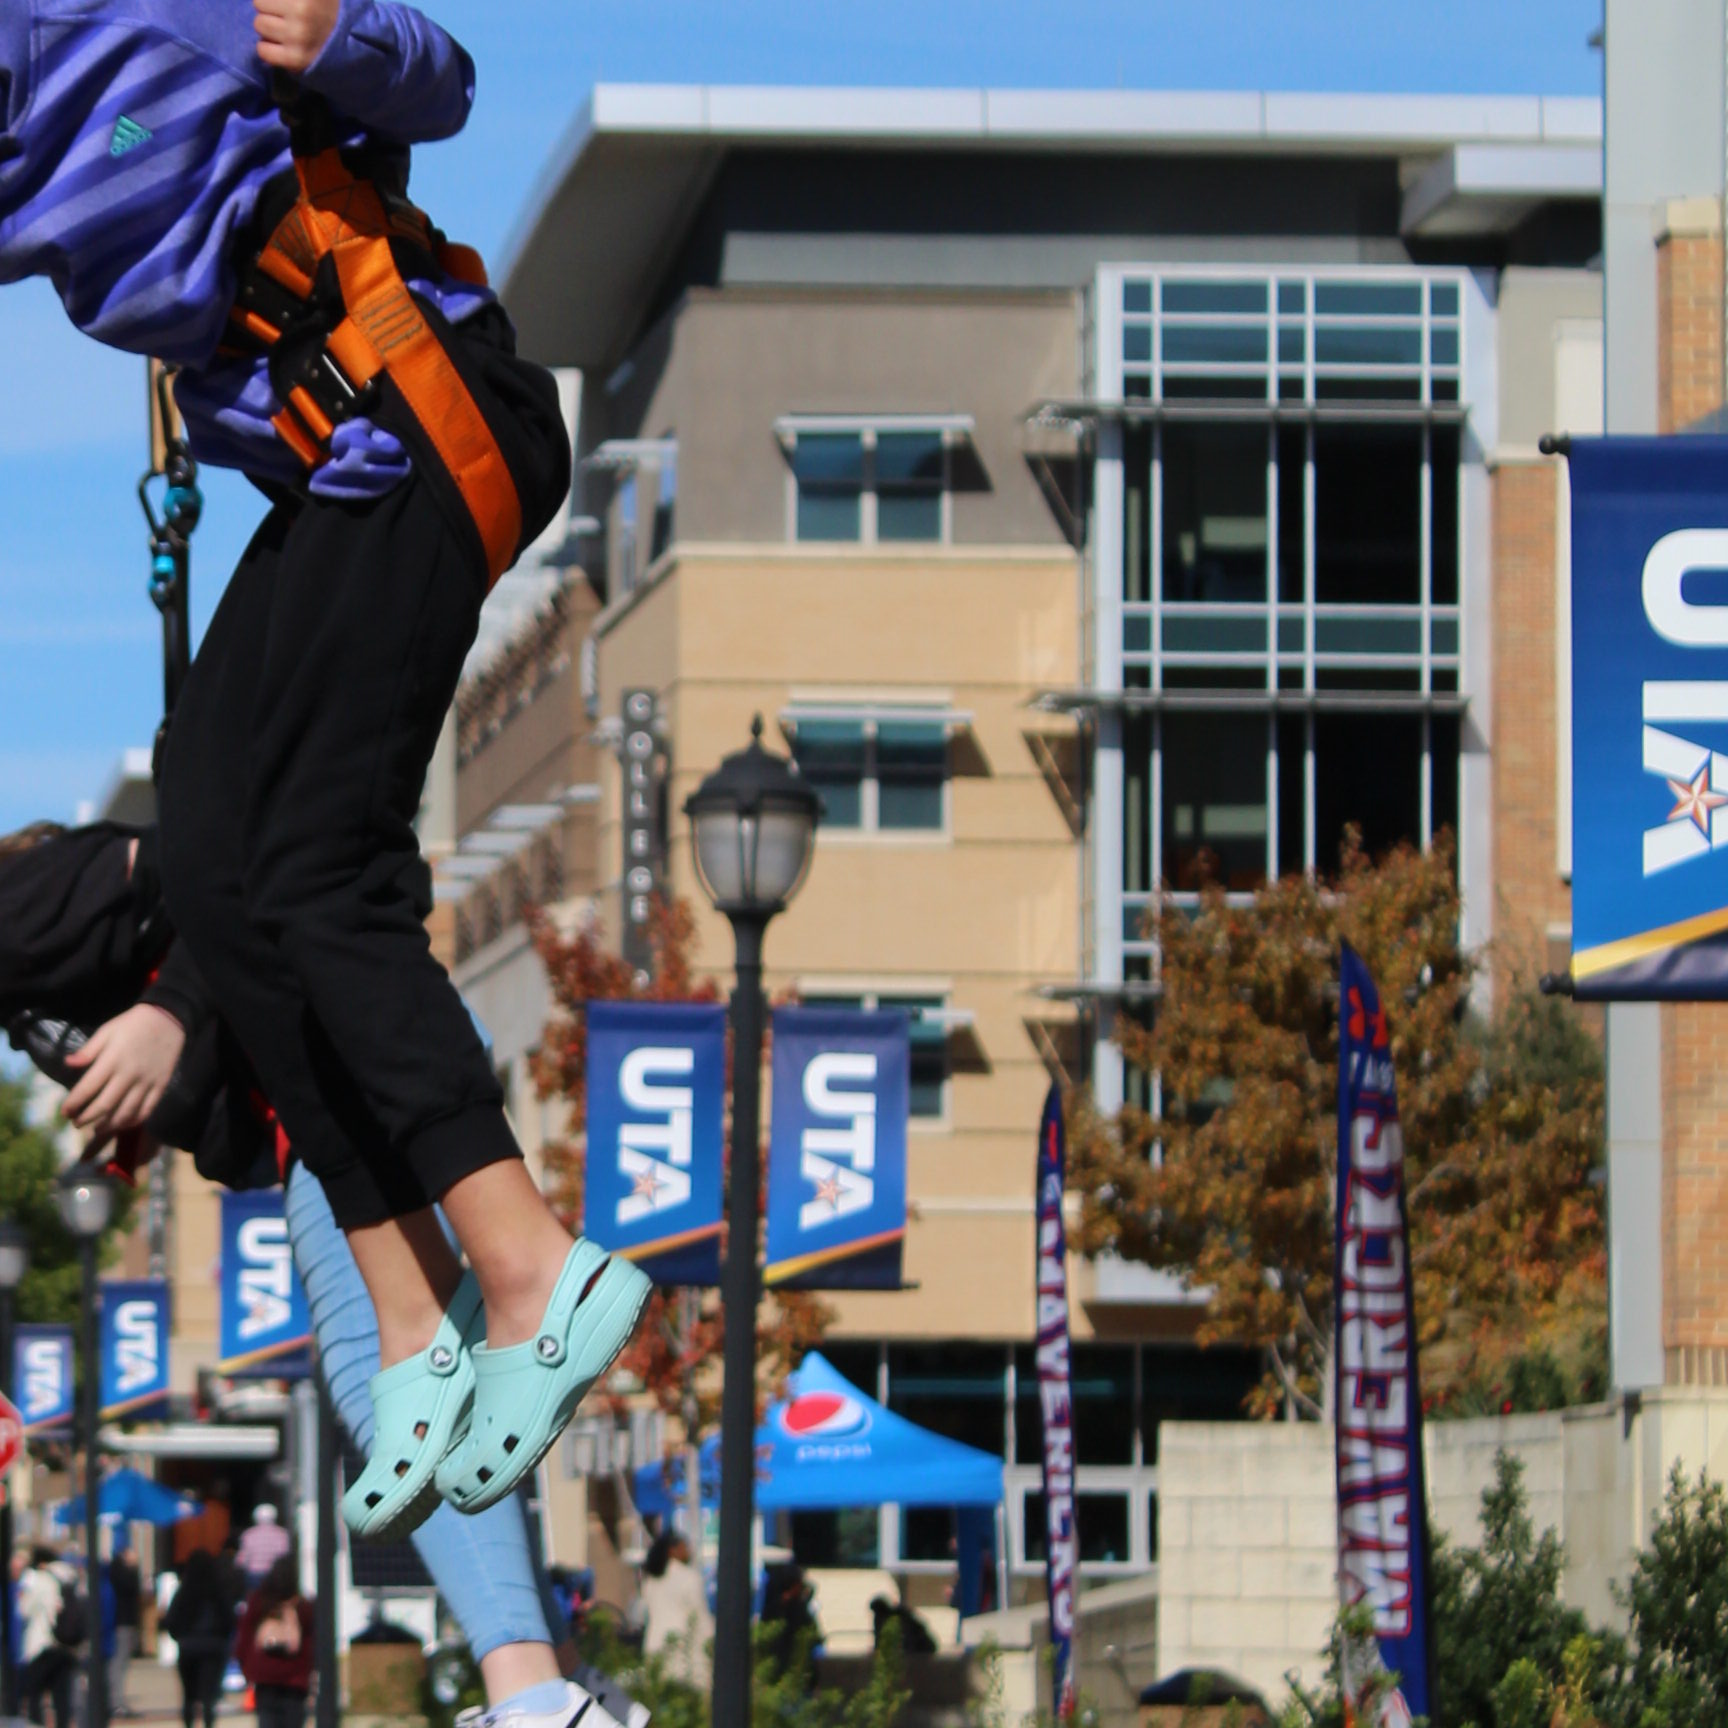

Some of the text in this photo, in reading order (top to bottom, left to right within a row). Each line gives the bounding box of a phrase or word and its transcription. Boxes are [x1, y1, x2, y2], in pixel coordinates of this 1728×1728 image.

[616, 1046, 694, 1226] UTA
[799, 1052, 878, 1232] UTA
[237, 1216, 292, 1339] UTA
[24, 1339, 62, 1417] UTA
[113, 1299, 158, 1393] UTA
[1342, 1109, 1411, 1636] MAVERICKS
[797, 1443, 871, 1463] pepsi
